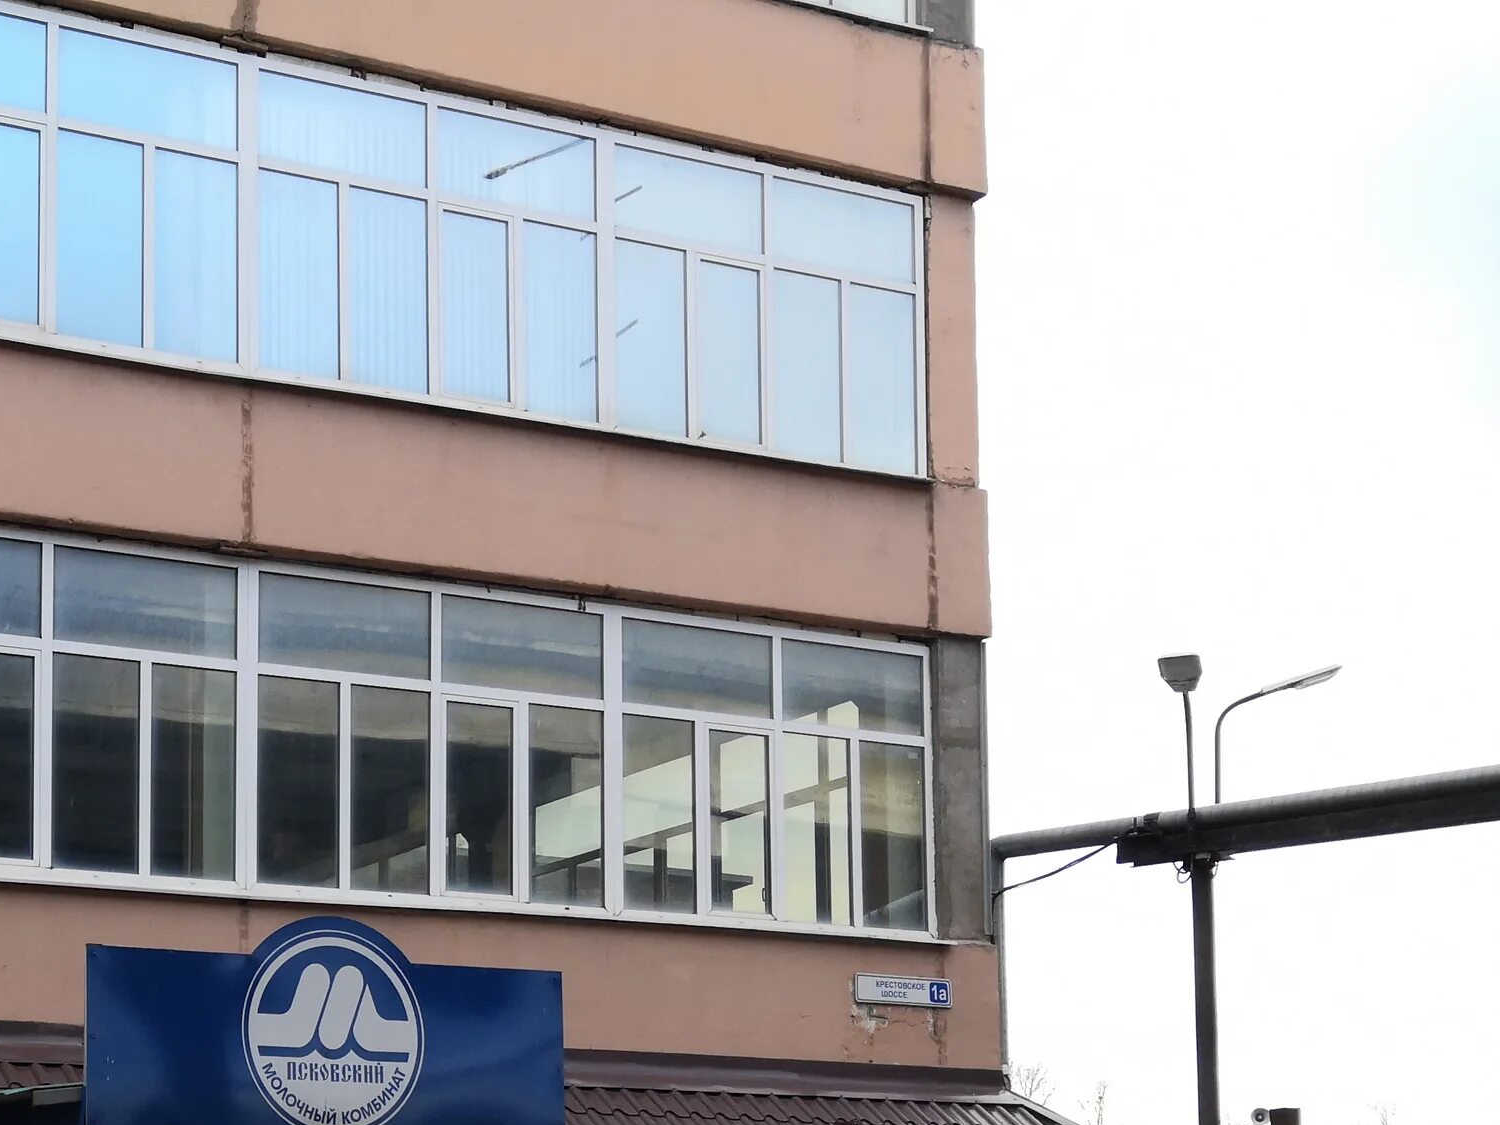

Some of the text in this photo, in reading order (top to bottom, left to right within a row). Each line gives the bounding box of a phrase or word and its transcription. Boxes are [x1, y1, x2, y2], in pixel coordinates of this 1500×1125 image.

[875, 980, 926, 990] КРЕСТОВСКОЕ
[881, 990, 908, 999] ШОССЕ
[287, 1061, 384, 1084] ПСКОВСКИЙ
[262, 1062, 407, 1125] МОЛОЧНЫЙ КОМБИНАТ
